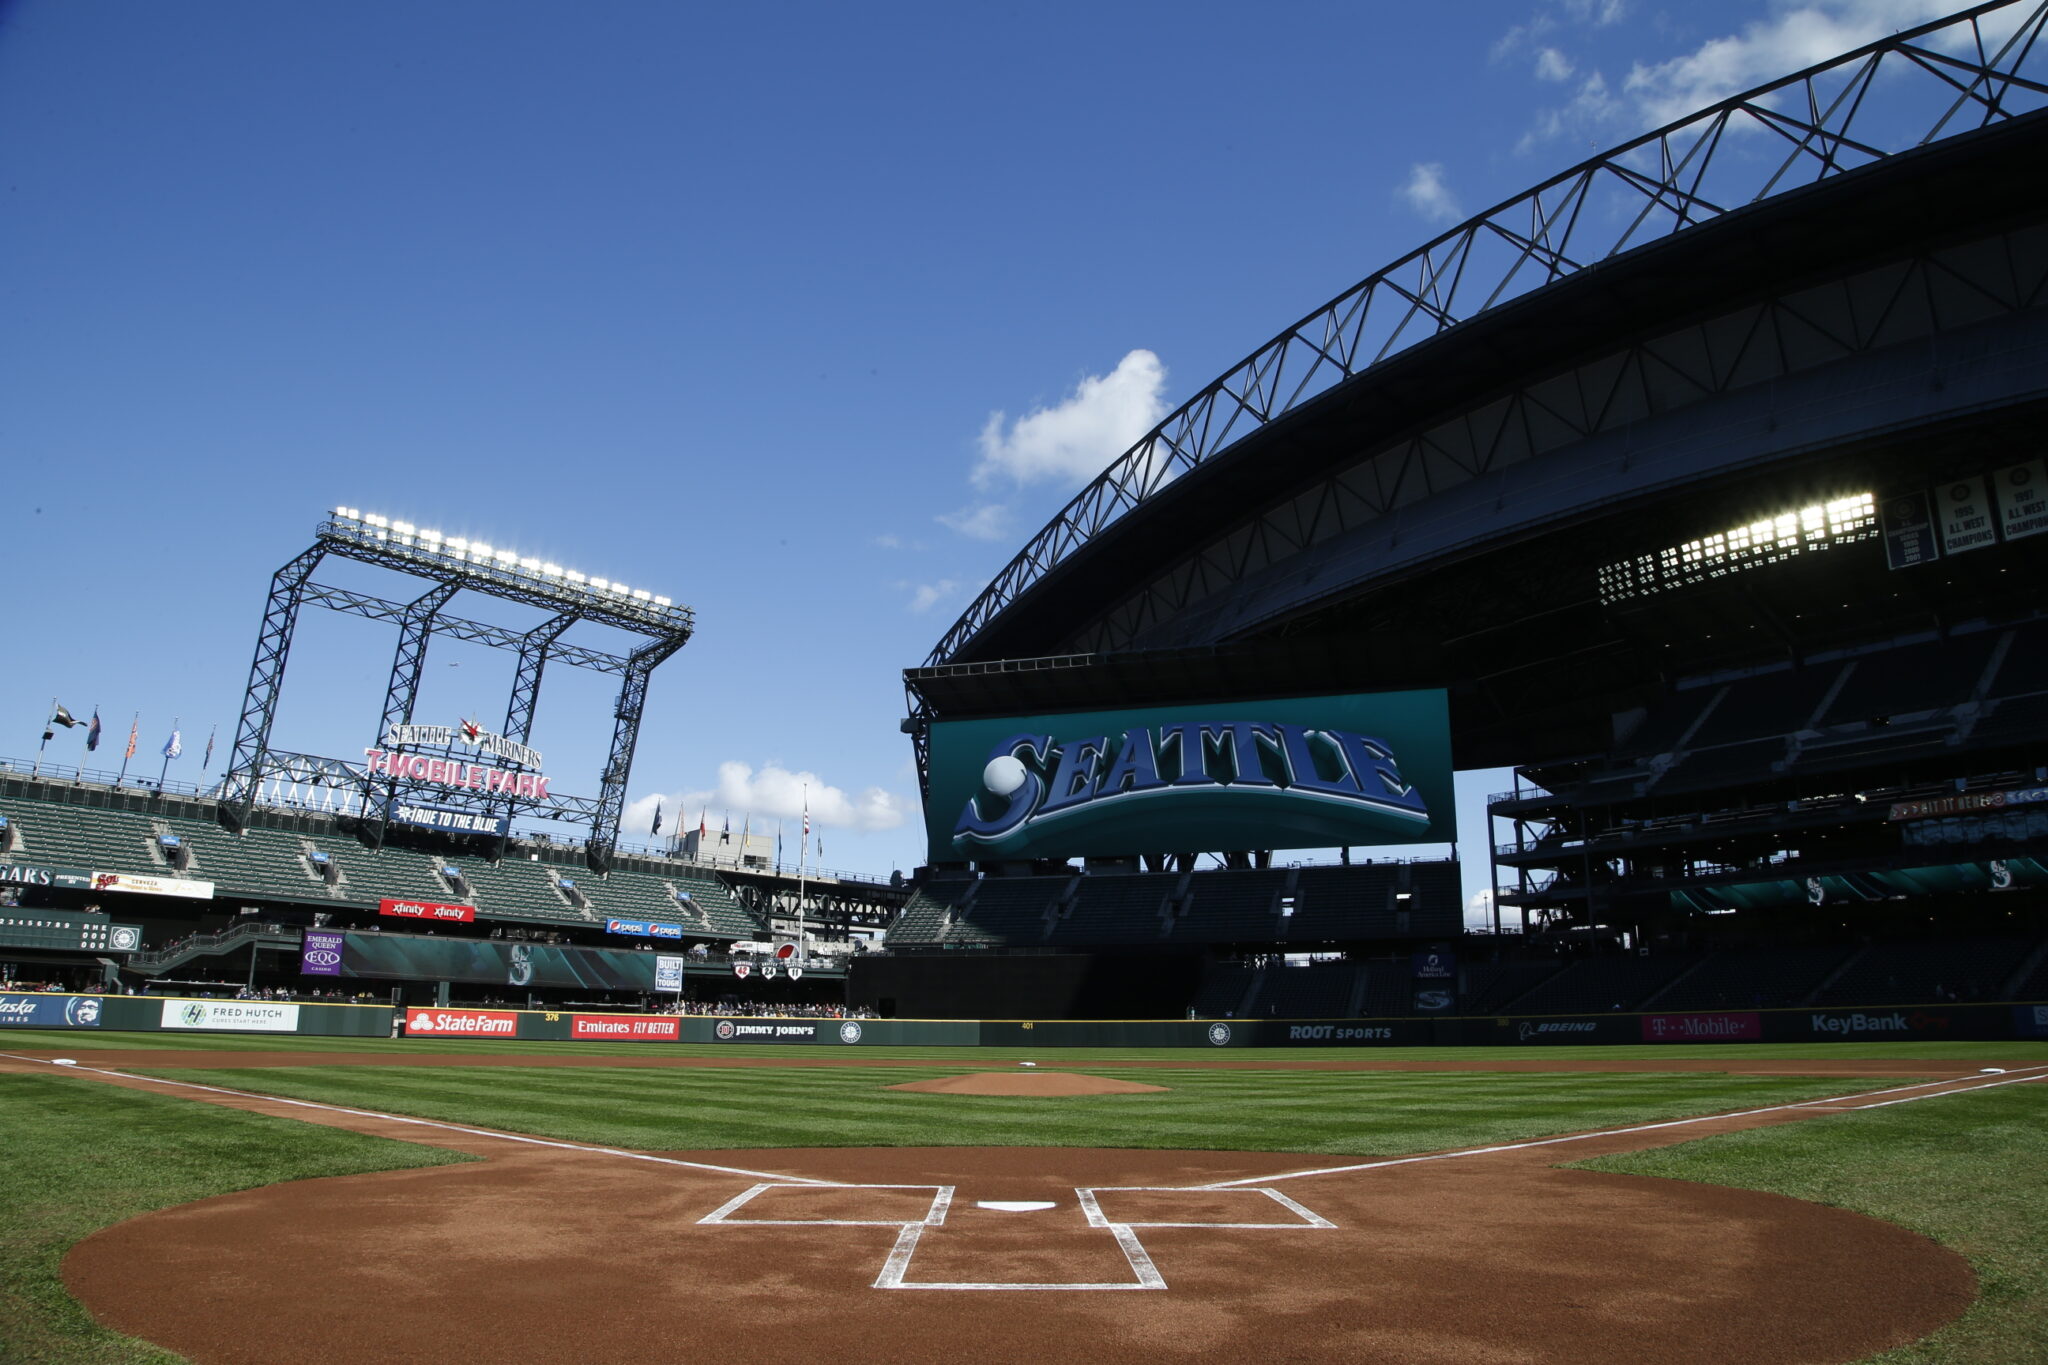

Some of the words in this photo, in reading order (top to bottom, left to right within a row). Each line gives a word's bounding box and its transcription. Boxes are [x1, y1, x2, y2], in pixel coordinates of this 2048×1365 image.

[2023, 501, 2046, 516] WEST
[1963, 517, 1985, 530] WEST
[1947, 530, 1993, 549] CHAMPIONS
[388, 723, 452, 745] SEATTLE
[482, 732, 542, 769] MARINERS
[365, 748, 483, 790] T-MOBILE
[486, 768, 551, 799] PARK
[953, 721, 1430, 846] SEATTLE
[410, 805, 436, 825] TRUE
[438, 811, 450, 826] TO
[452, 813, 471, 829] THE
[473, 815, 500, 832] BLUE
[393, 902, 425, 916] xfinity
[434, 906, 465, 919] xfinity
[621, 923, 643, 934] pepsi
[660, 927, 680, 936] pepsi
[307, 935, 342, 944] EMERALD
[659, 959, 680, 969] BUILT
[738, 966, 747, 975] 42
[764, 967, 774, 976] 24
[658, 979, 680, 987] TOUGH
[213, 1008, 242, 1017] FRED
[246, 1009, 282, 1018] HUTCH
[578, 1020, 630, 1033] Emirates
[633, 1021, 647, 1033] FLY
[648, 1022, 675, 1034] BETTER
[1537, 1022, 1597, 1032] BOEING
[1811, 1013, 1909, 1034] KeyBank
[736, 1026, 774, 1036] JIMMY
[1289, 1026, 1334, 1039] ROOT
[1335, 1028, 1393, 1039] SPORTS
